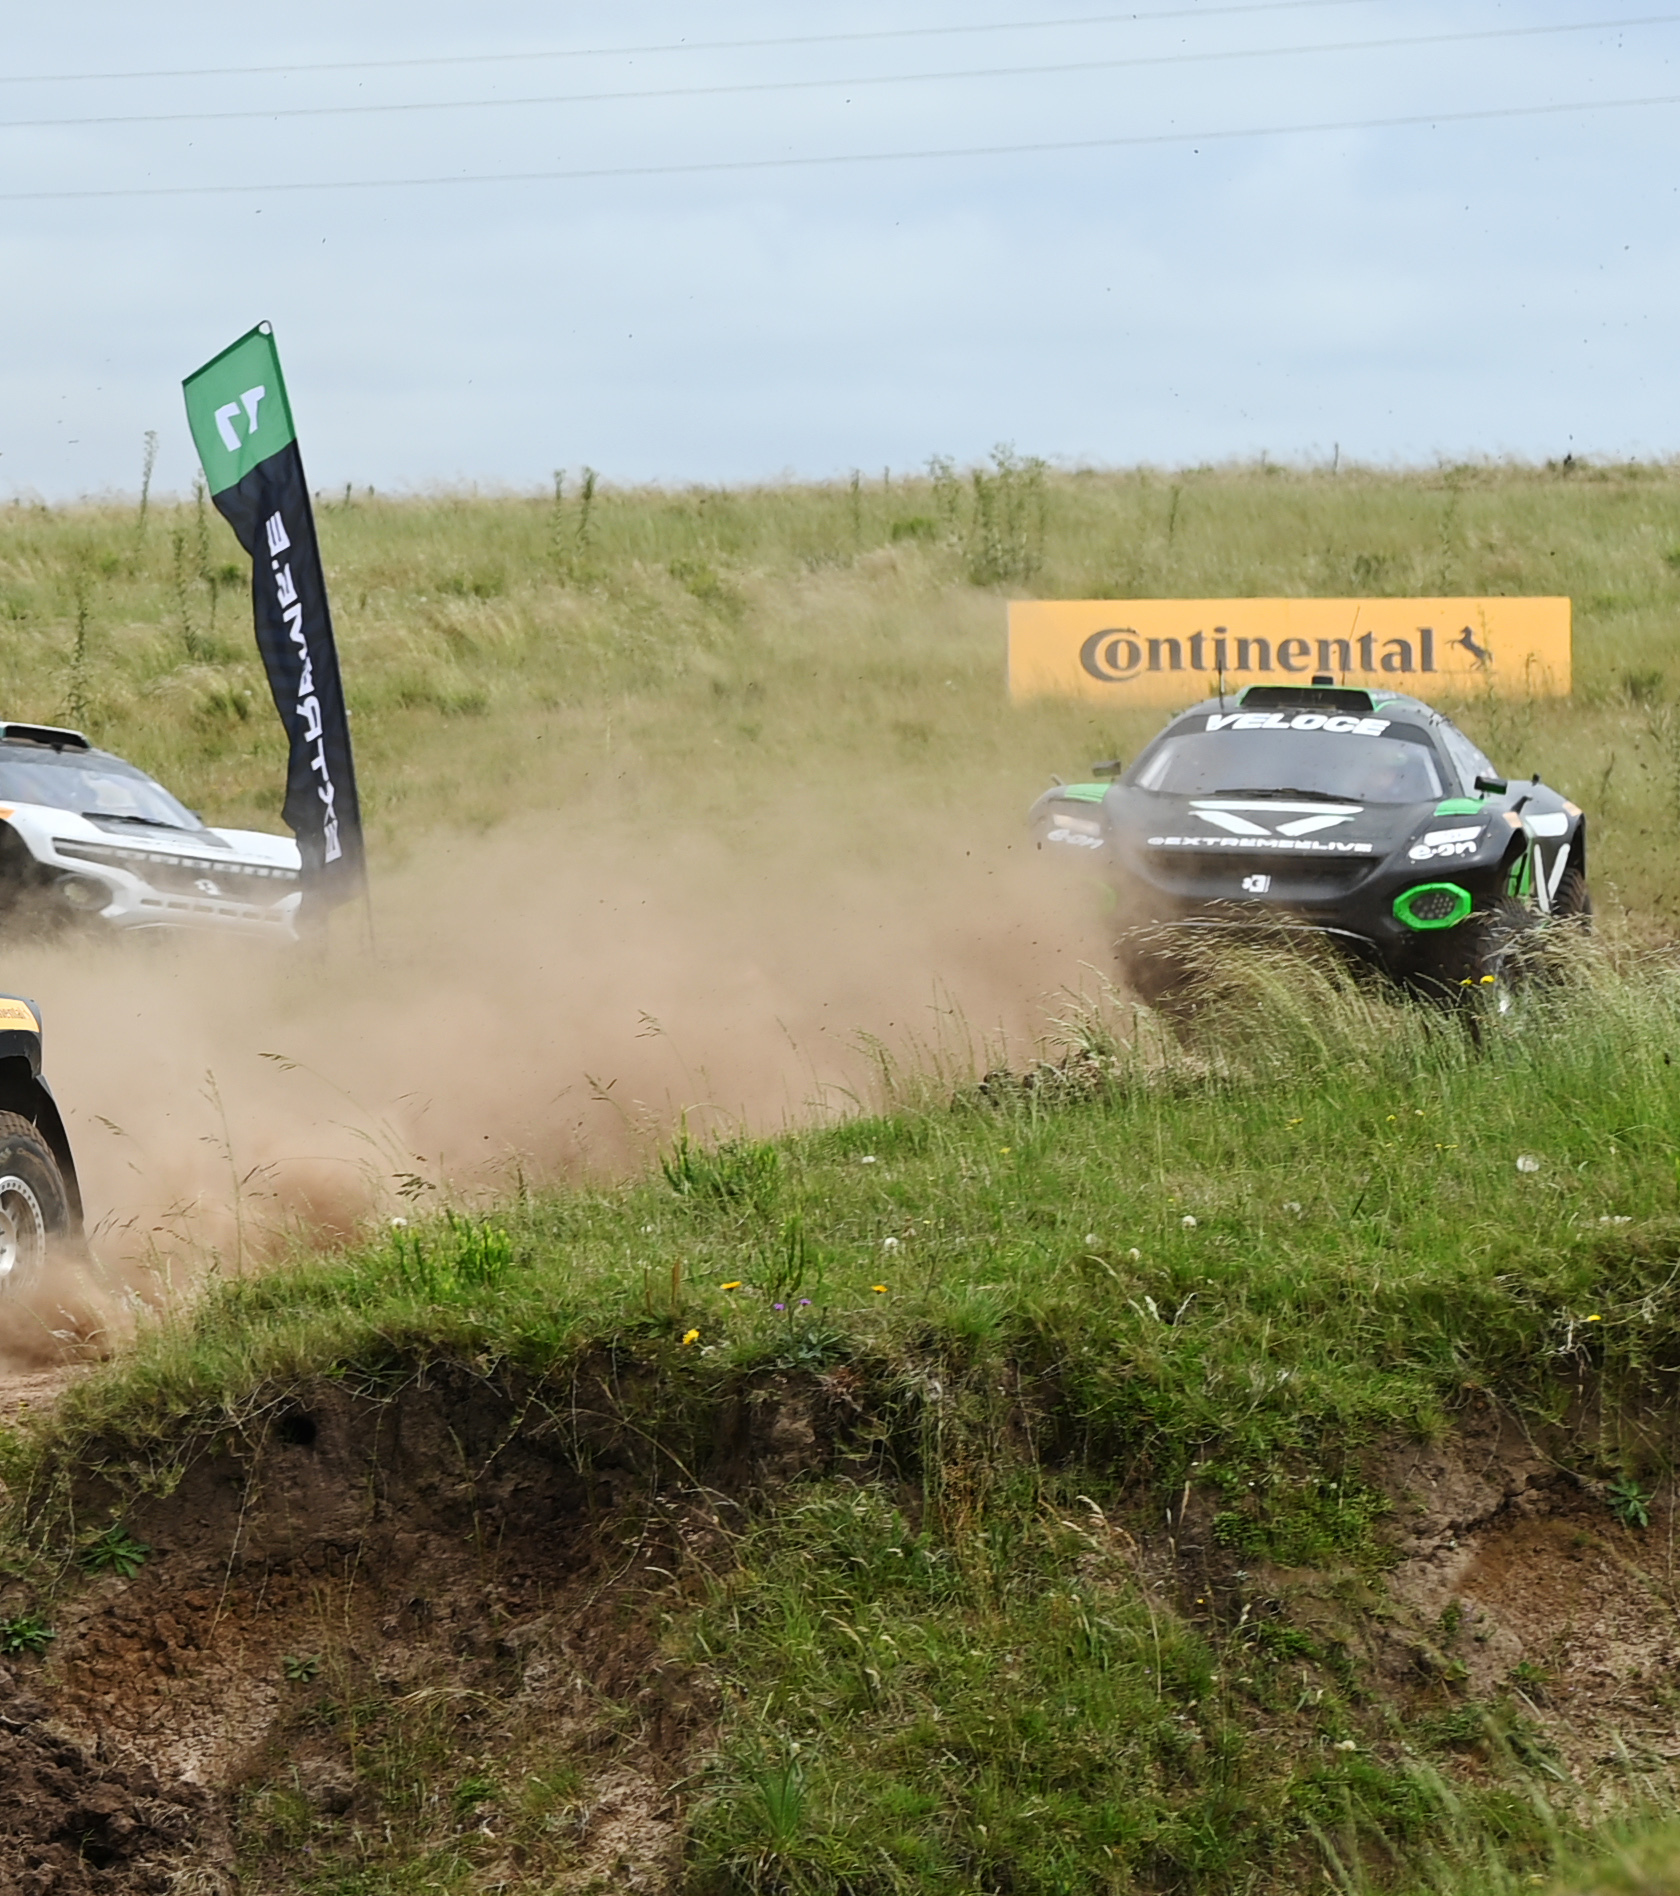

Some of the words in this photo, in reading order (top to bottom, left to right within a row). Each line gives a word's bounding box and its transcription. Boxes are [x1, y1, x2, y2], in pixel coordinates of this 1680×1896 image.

[1080, 625, 1439, 683] Continental
[1205, 713, 1392, 737] VELOCE
[1147, 836, 1374, 853] @EXTREMEELIVE
